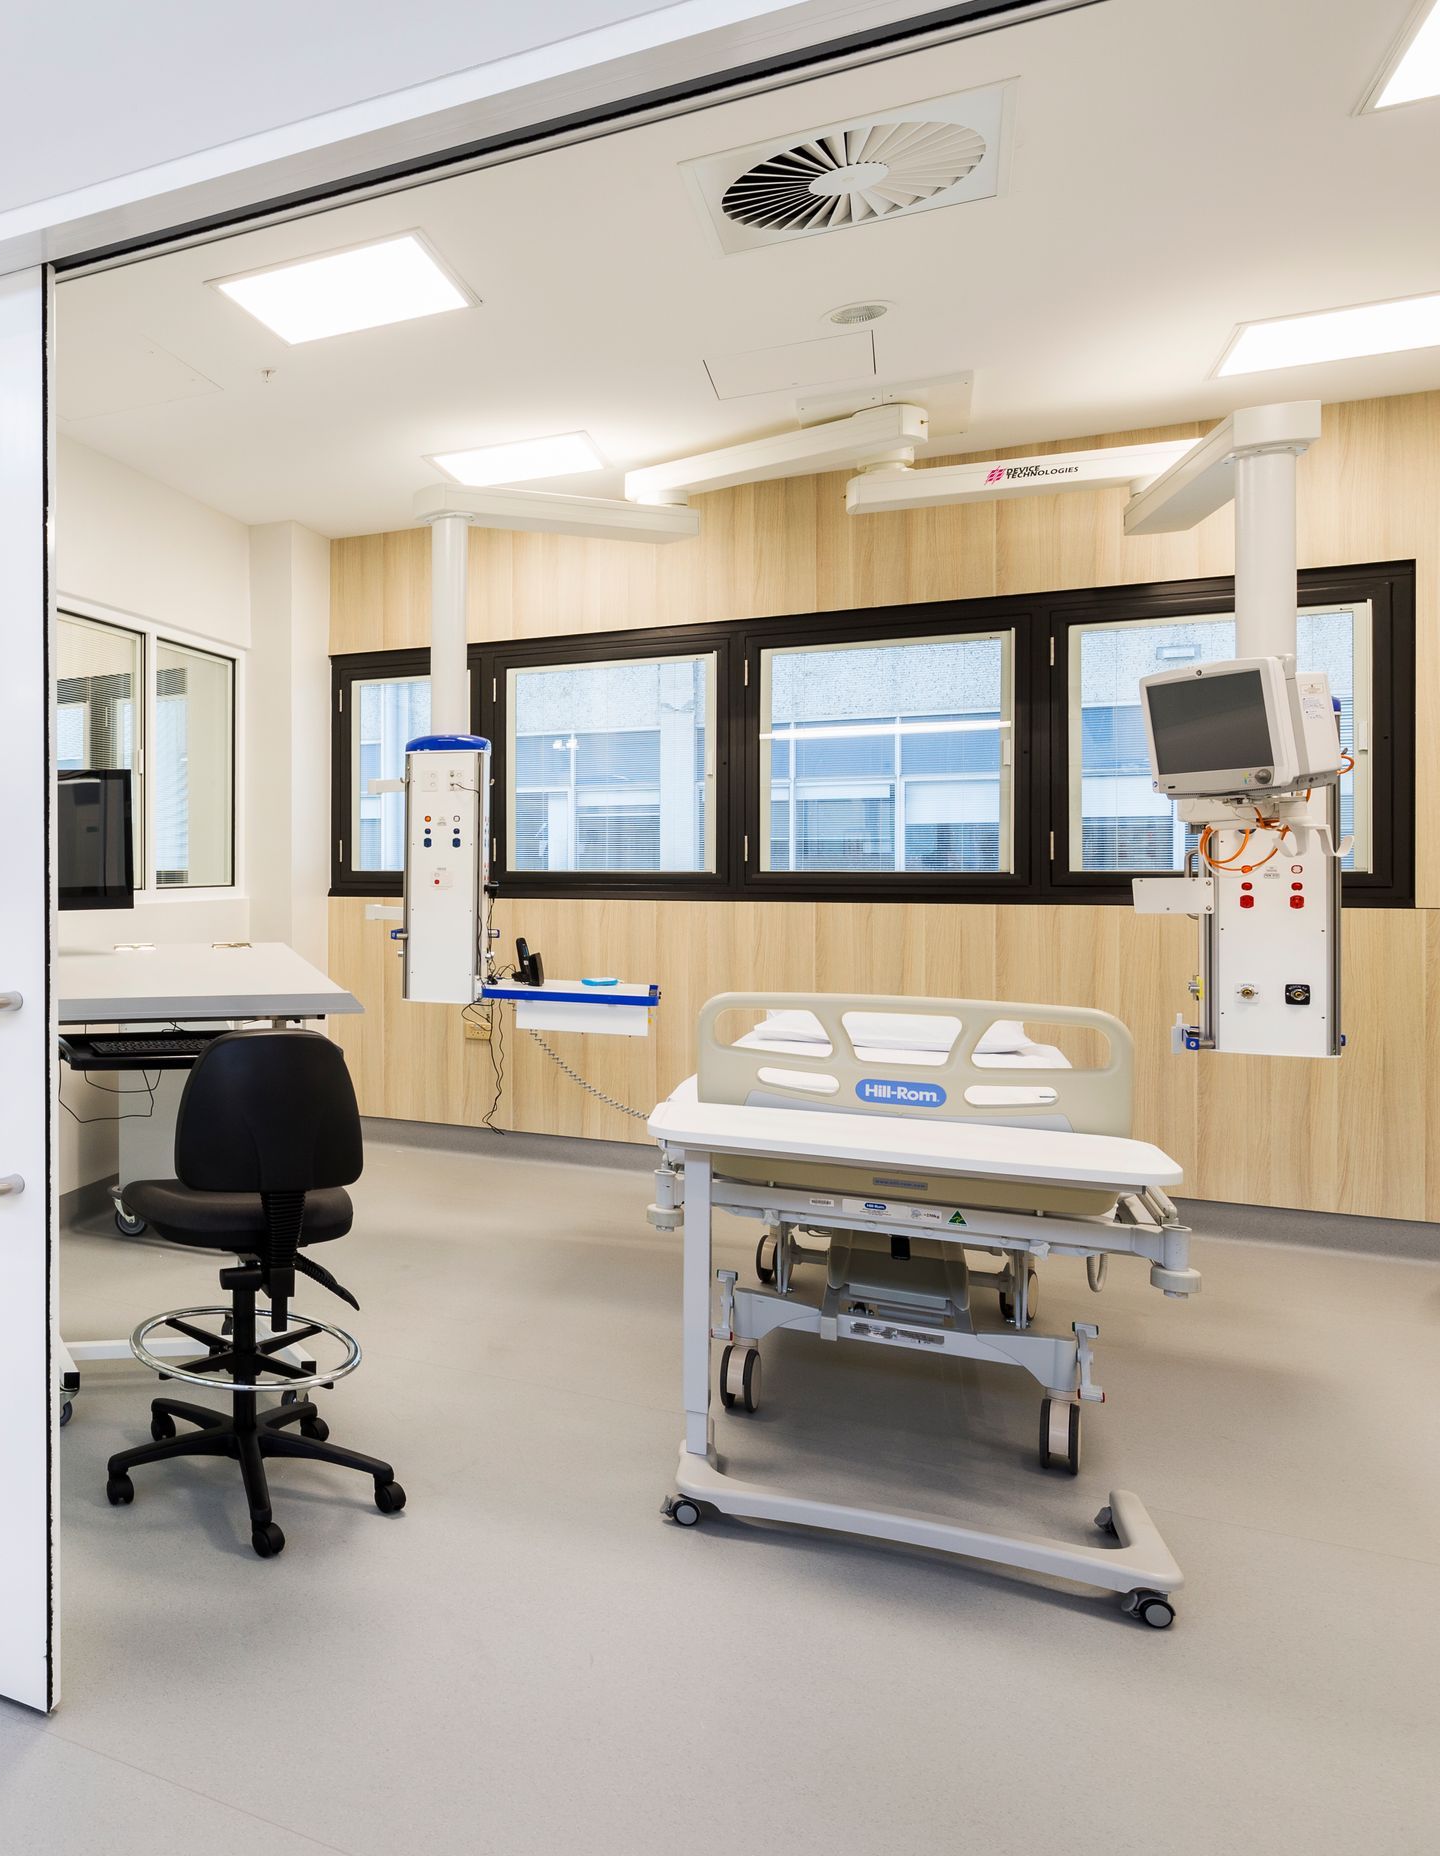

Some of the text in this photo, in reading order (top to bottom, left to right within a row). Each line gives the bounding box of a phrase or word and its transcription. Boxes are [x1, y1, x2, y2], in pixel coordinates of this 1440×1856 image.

[1006, 465, 1041, 476] DEVICE
[1006, 466, 1079, 479] TECHNOLOGIES
[865, 1083, 938, 1103] Hill-Rom
